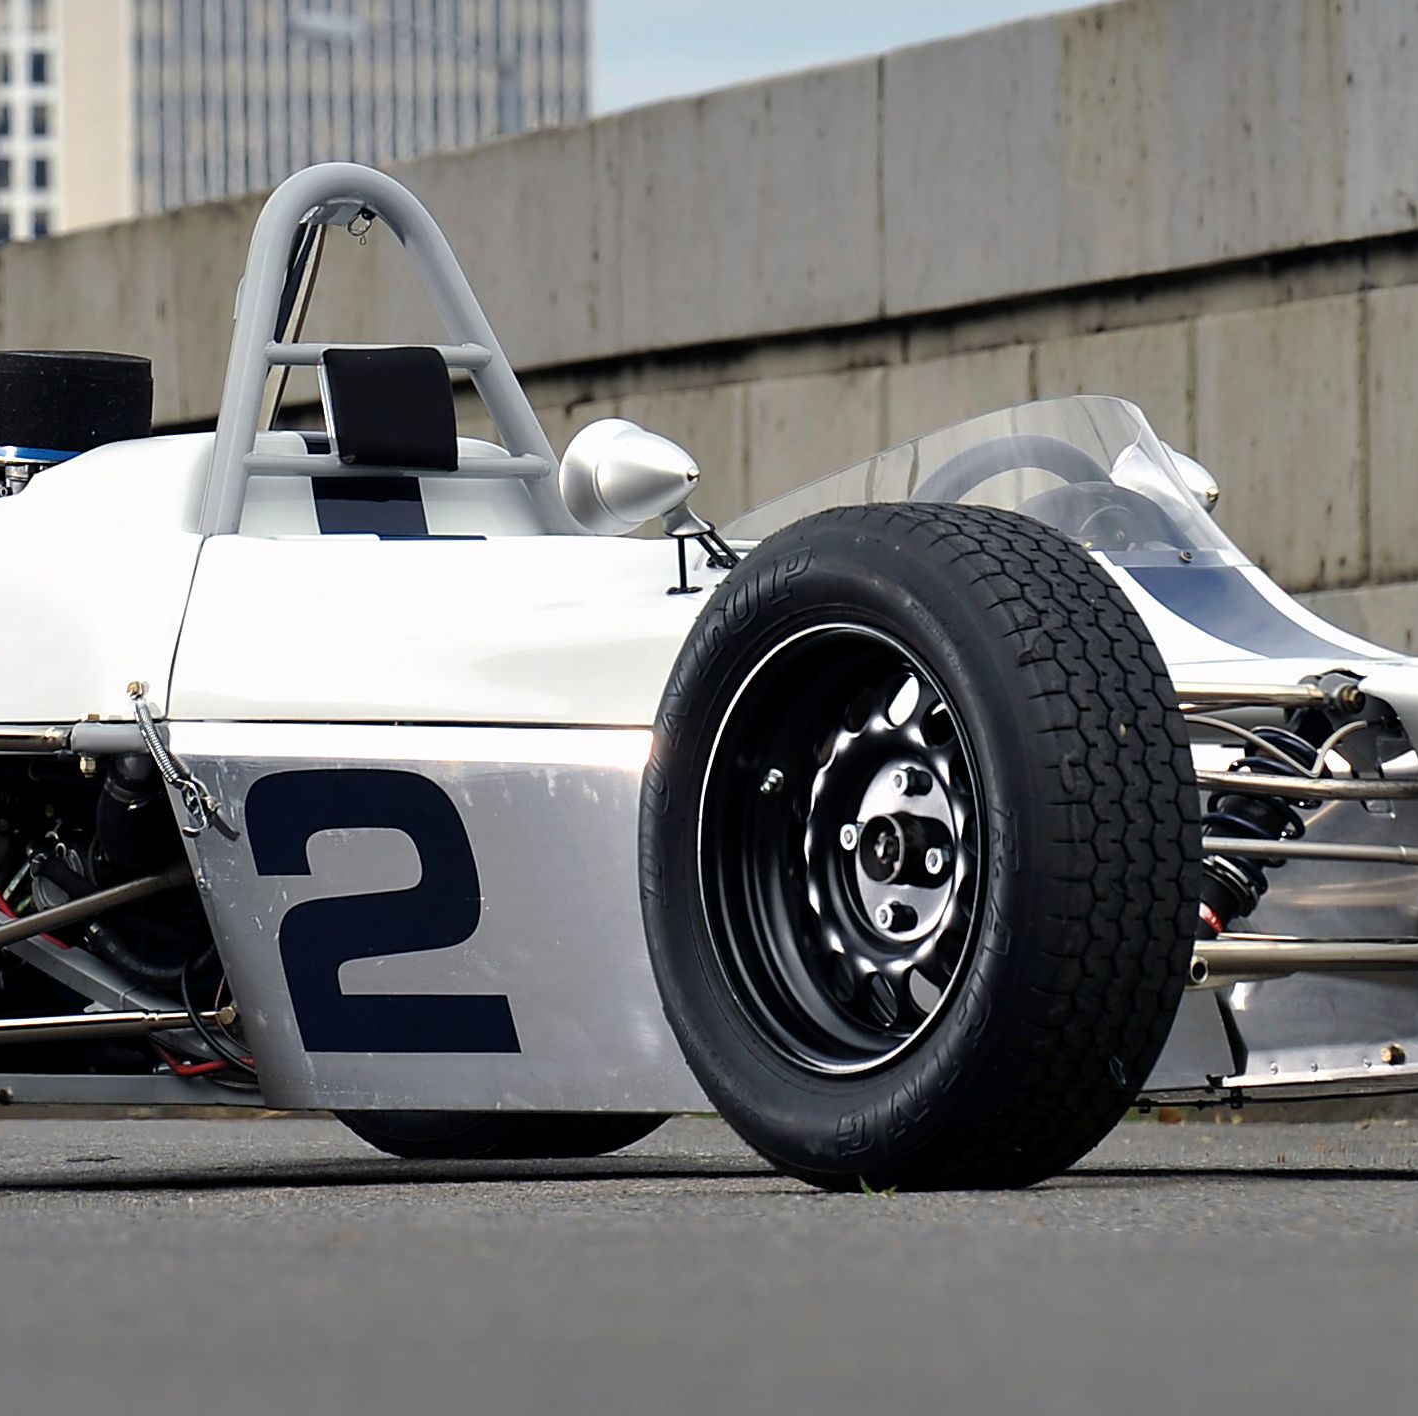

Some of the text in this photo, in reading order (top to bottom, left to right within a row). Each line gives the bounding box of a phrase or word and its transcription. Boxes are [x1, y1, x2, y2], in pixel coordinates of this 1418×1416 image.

[641, 545, 813, 907] DUNLOP
[245, 768, 522, 1053] 2
[836, 807, 1021, 1157] RACING
